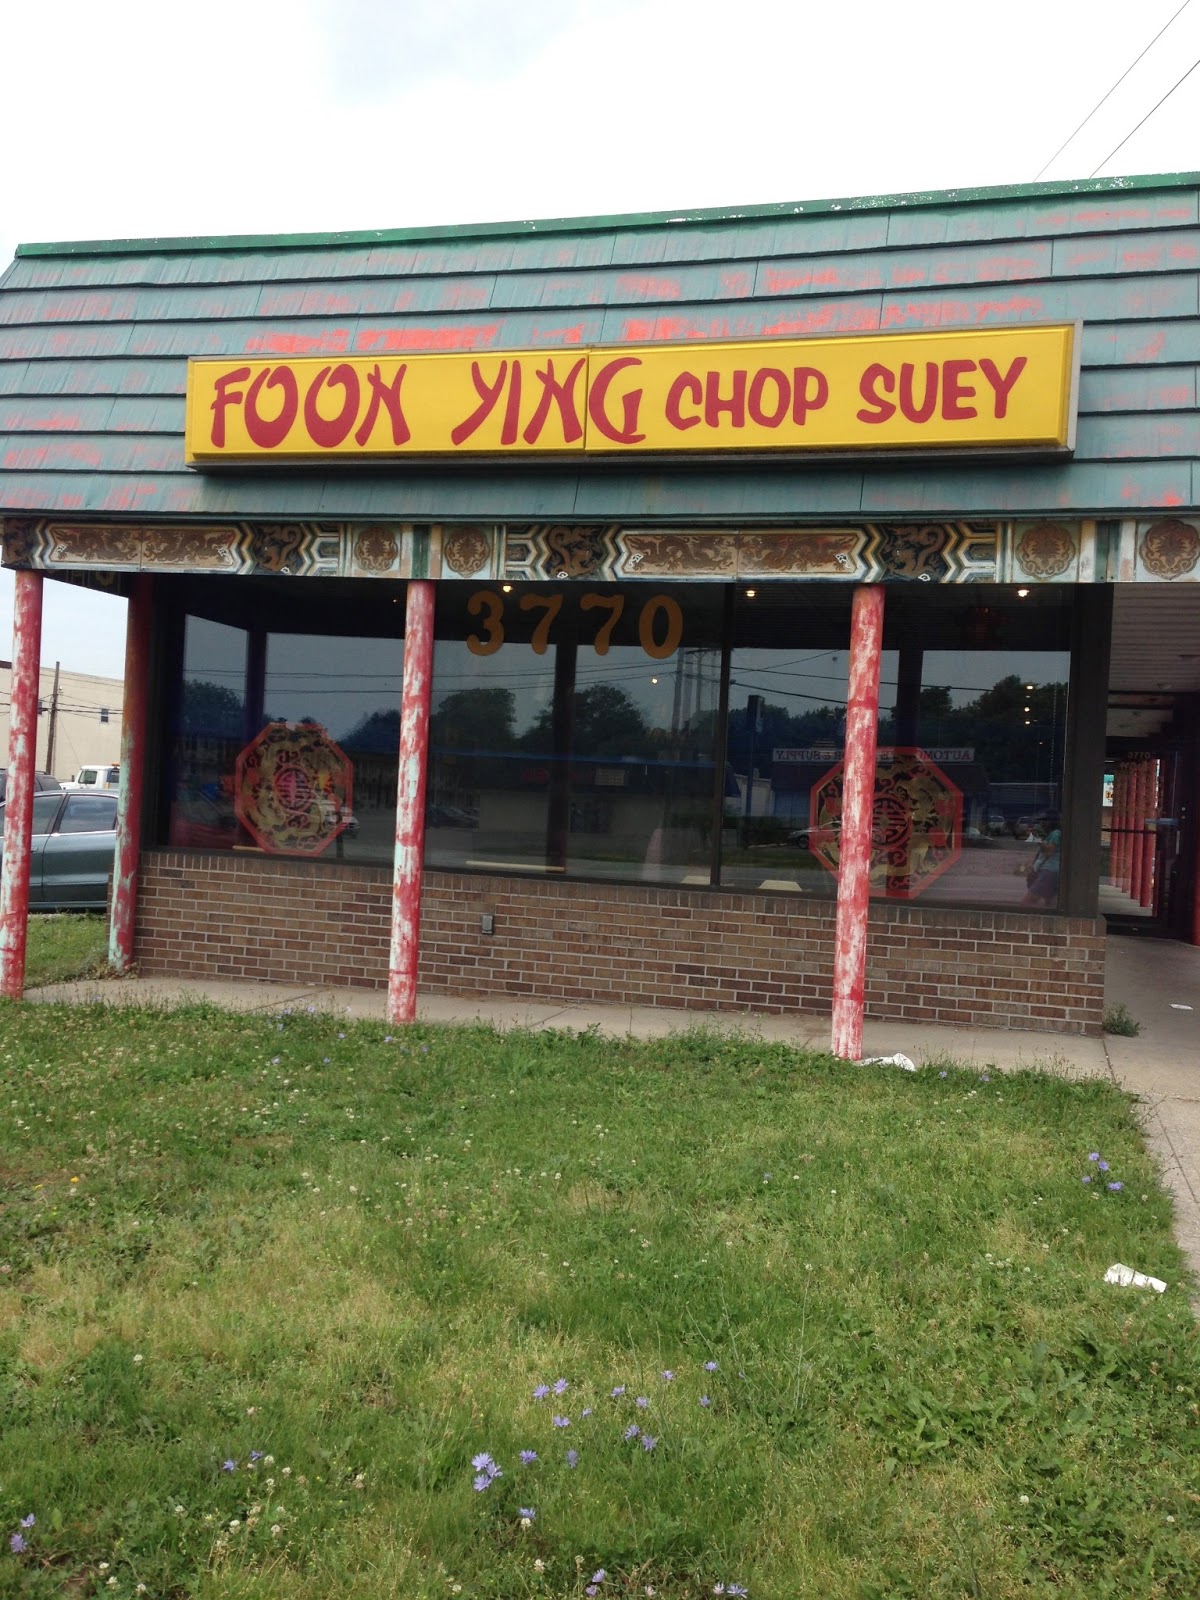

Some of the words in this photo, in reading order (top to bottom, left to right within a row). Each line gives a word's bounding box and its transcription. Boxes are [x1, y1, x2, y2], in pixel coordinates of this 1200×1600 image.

[210, 363, 411, 448] FOON
[451, 357, 646, 447] YING
[665, 366, 829, 431] CHOP
[856, 356, 1028, 424] SUEY
[466, 590, 683, 660] 3770
